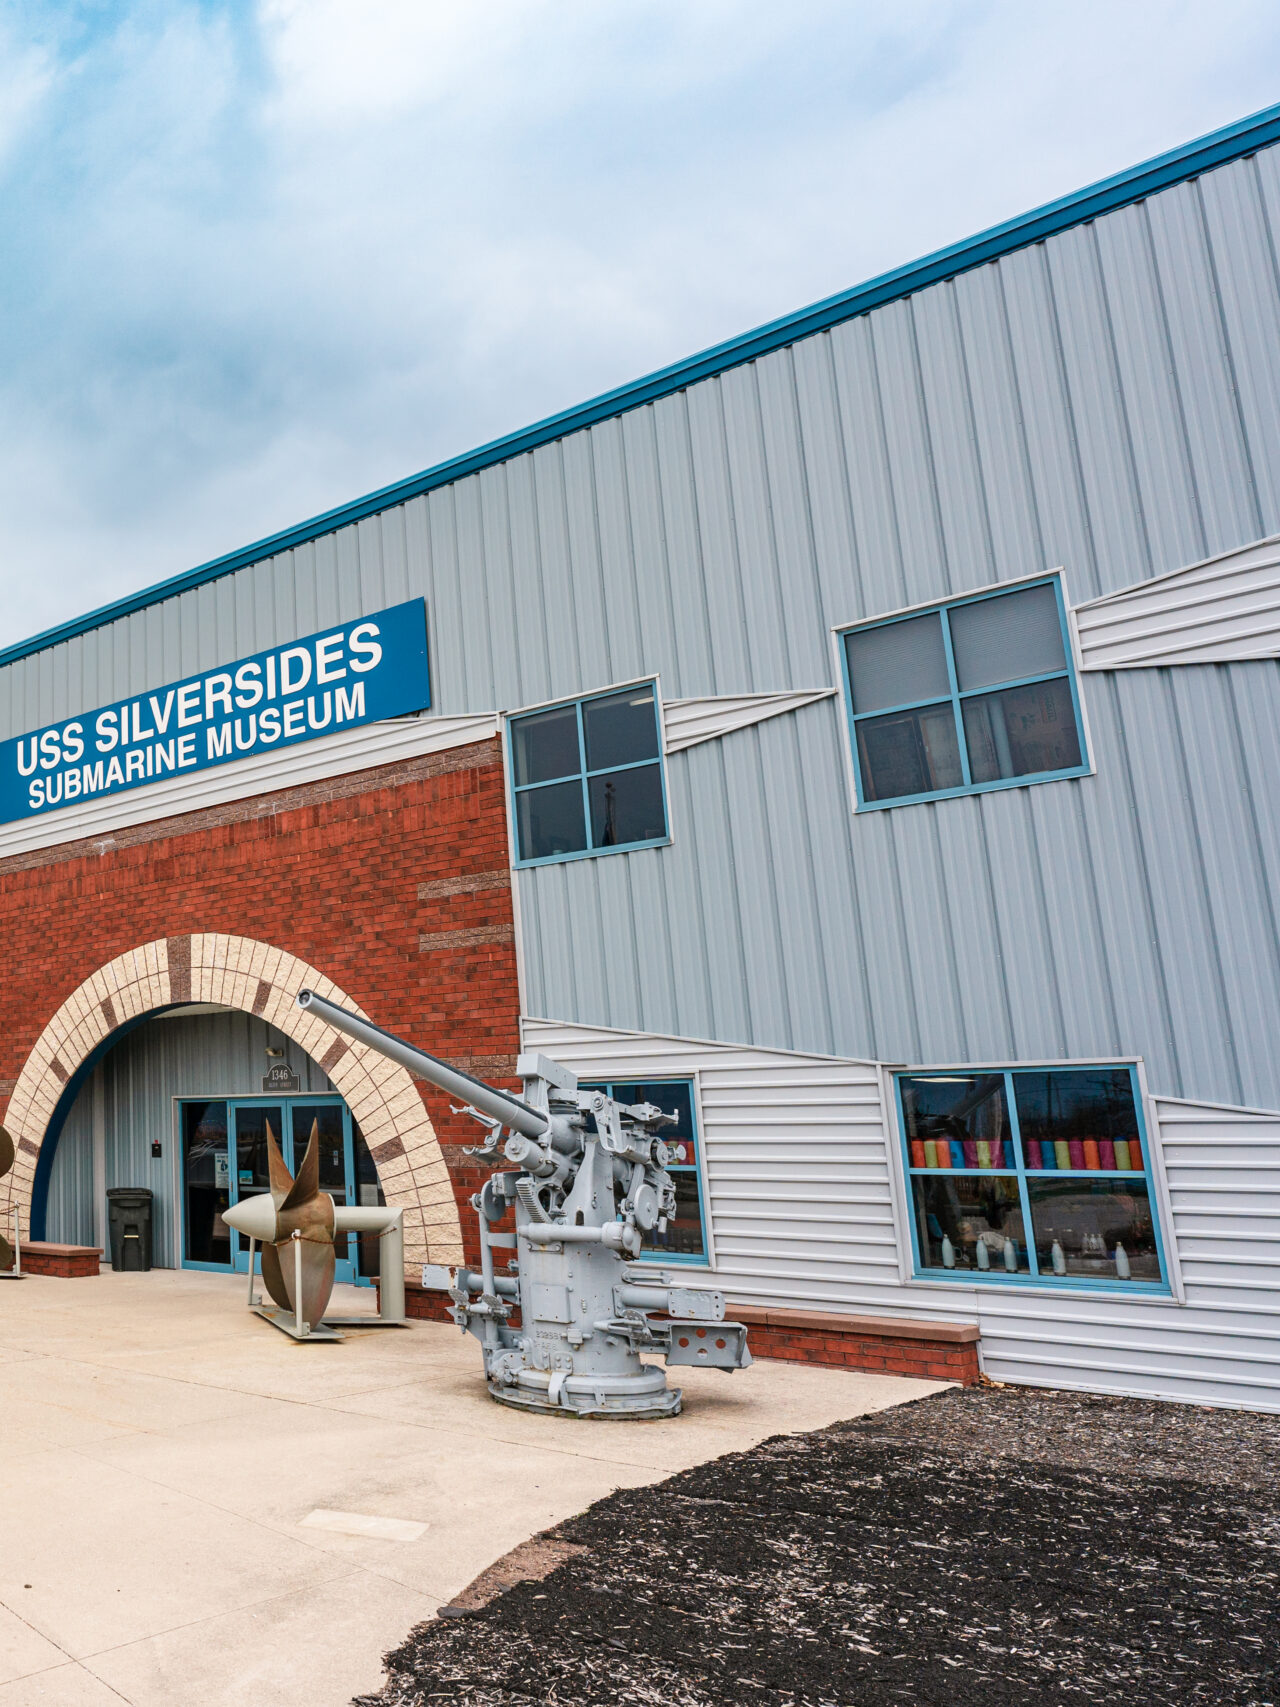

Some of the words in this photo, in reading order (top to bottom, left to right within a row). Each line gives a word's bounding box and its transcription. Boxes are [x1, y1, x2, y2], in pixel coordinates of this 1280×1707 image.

[16, 722, 85, 777] USS
[95, 622, 383, 753] SILVERSIDES
[28, 732, 198, 809] SUBMARINE
[206, 681, 366, 758] MUSEUM
[271, 1069, 288, 1081] 1346
